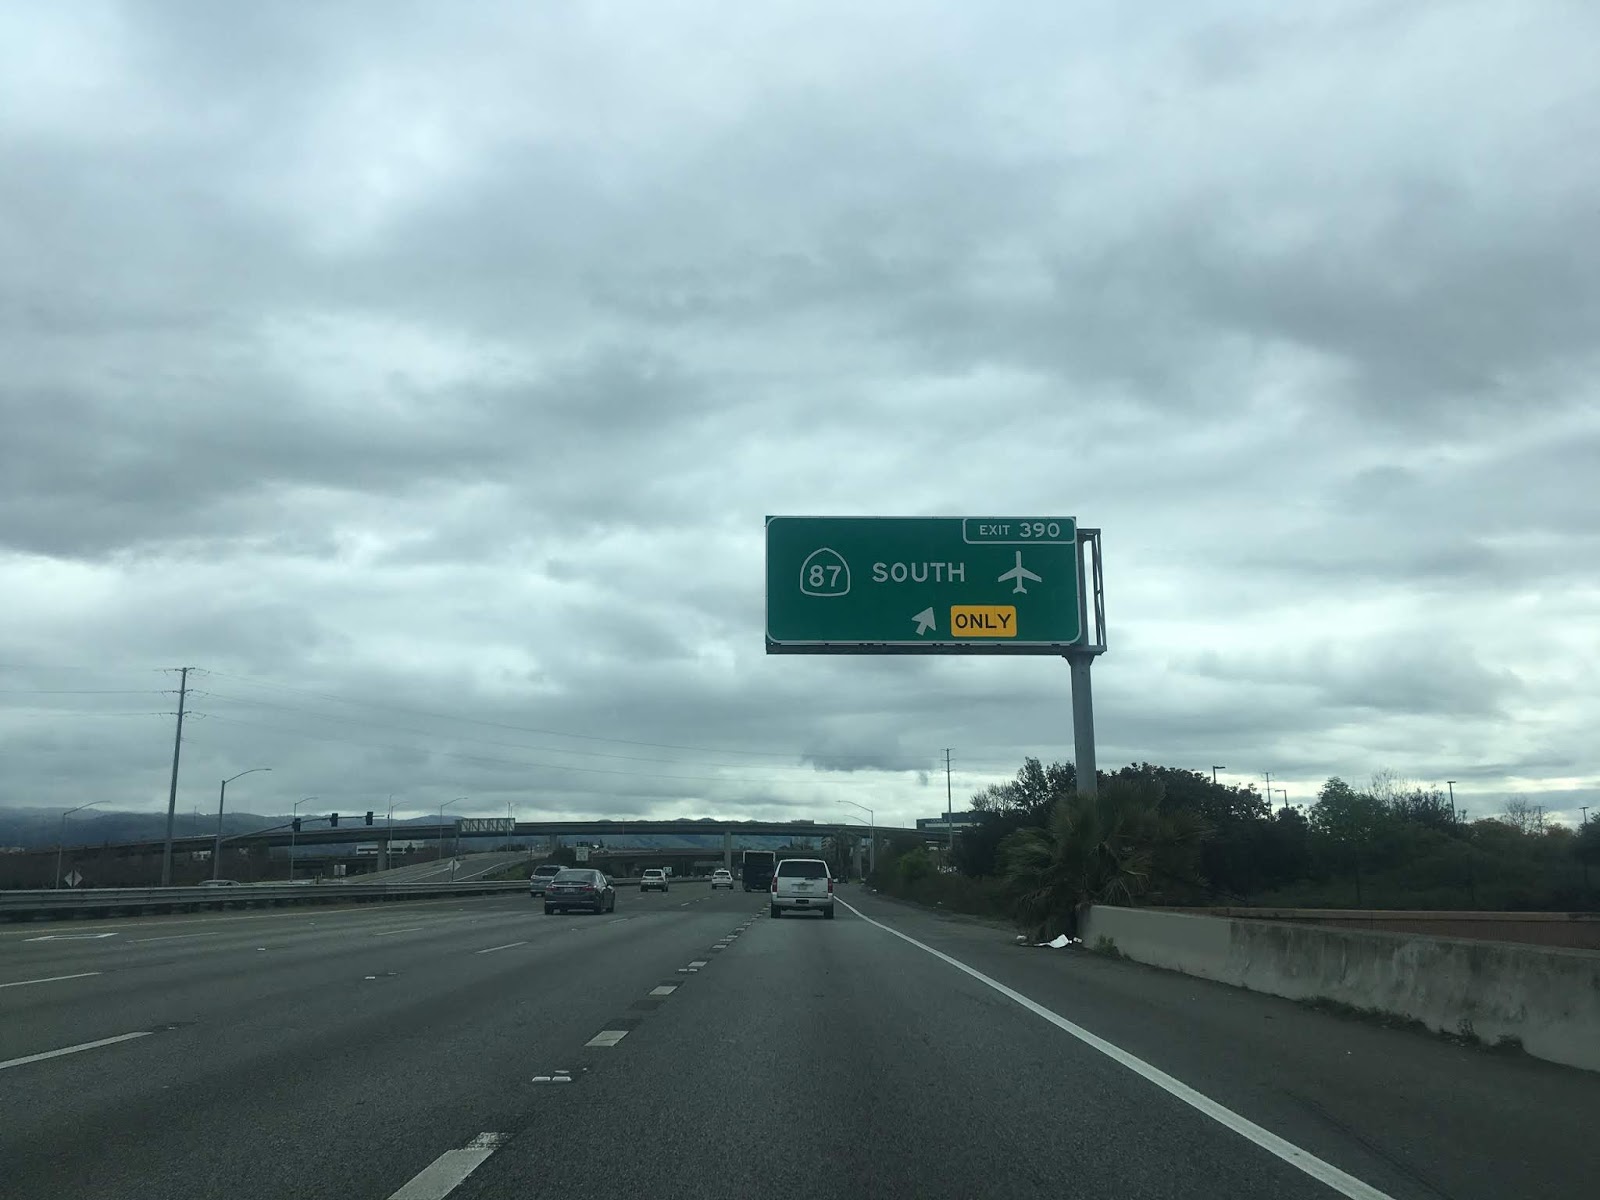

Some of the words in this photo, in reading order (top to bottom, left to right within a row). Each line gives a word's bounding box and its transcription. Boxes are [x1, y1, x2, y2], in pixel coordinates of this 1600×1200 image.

[979, 525, 1010, 536] EXIT
[1019, 523, 1060, 538] 390
[809, 565, 842, 587] 87
[872, 562, 965, 582] SOUTH
[955, 614, 1011, 629] ONLY
